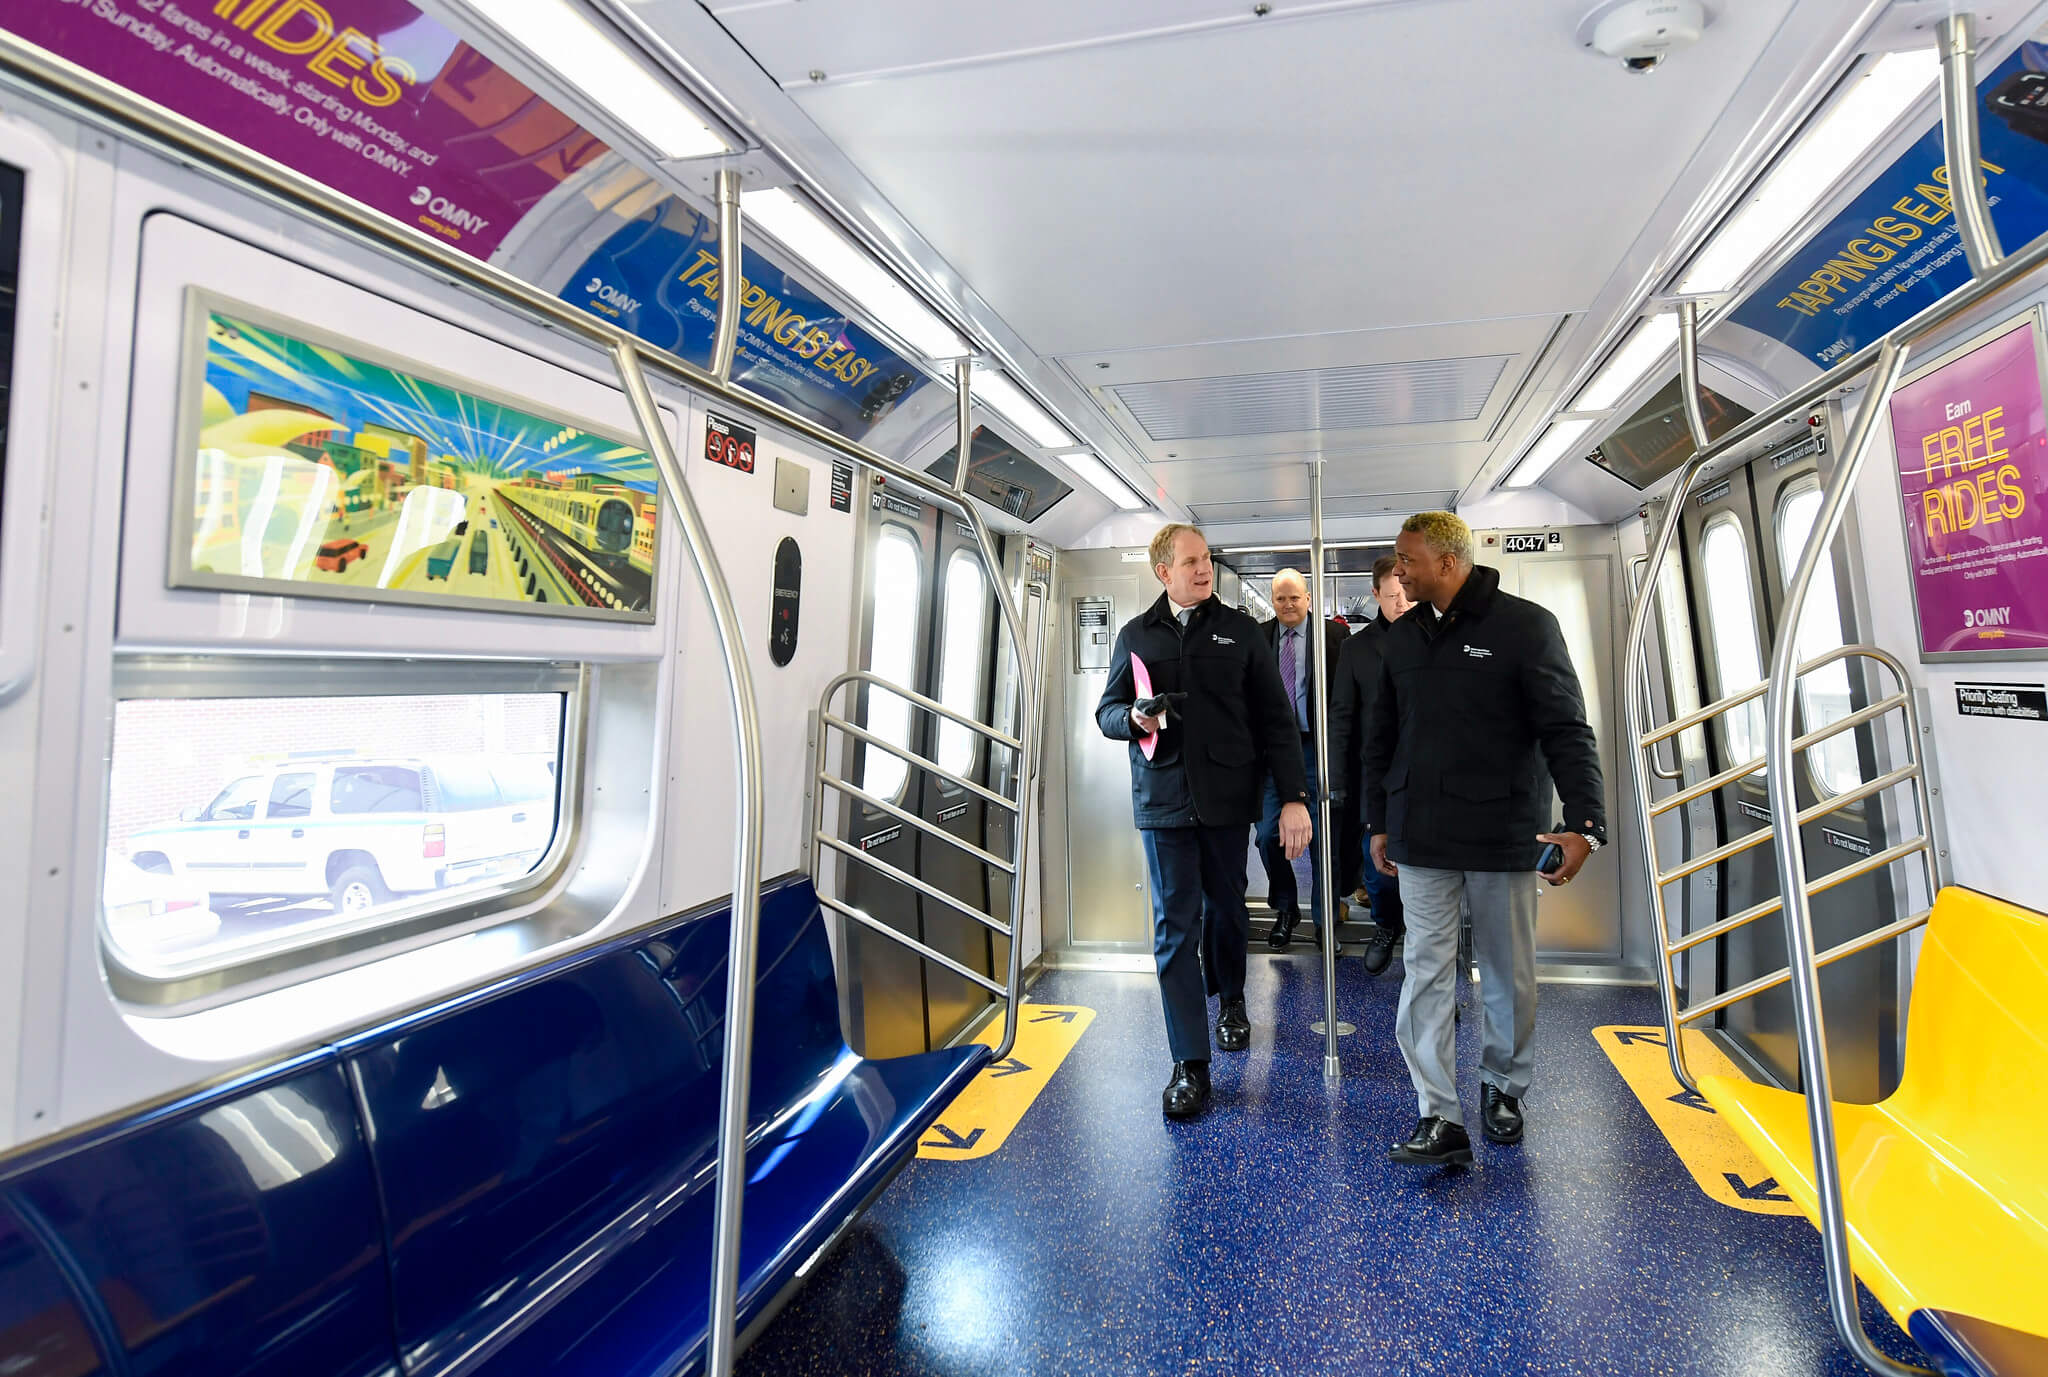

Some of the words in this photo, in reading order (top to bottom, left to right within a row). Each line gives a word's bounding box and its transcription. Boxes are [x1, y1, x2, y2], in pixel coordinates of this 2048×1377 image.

[91, 0, 176, 53] Sunday.
[174, 43, 293, 116] Automatically.
[294, 107, 332, 136] Only
[331, 127, 363, 153] with
[362, 144, 414, 178] OMNY.
[160, 3, 212, 41] fares
[210, 30, 232, 51] in
[228, 45, 245, 59] a
[243, 52, 293, 88] week,
[293, 81, 353, 121] starting
[352, 111, 410, 154] Monday,
[407, 147, 439, 166] and
[428, 197, 489, 235] OMNY
[1776, 239, 1898, 317] TAPPING
[1865, 216, 1923, 248] IS
[1914, 264, 1933, 278] Start
[1929, 248, 1962, 270] tapping
[598, 286, 642, 313] OMNY
[687, 297, 702, 313] Pay
[792, 326, 832, 360] IS
[814, 341, 879, 387] EASY
[1945, 400, 1972, 421] Earn
[708, 417, 730, 435] Please
[1816, 438, 1825, 452] L7
[1922, 406, 2009, 484] FREE
[1923, 465, 2025, 537] RIDES
[1507, 537, 1545, 551] 4047
[1551, 533, 1558, 543] 2
[1975, 606, 2011, 626] OMNY
[1960, 689, 1986, 705] Priority
[1987, 689, 2018, 707] Seating
